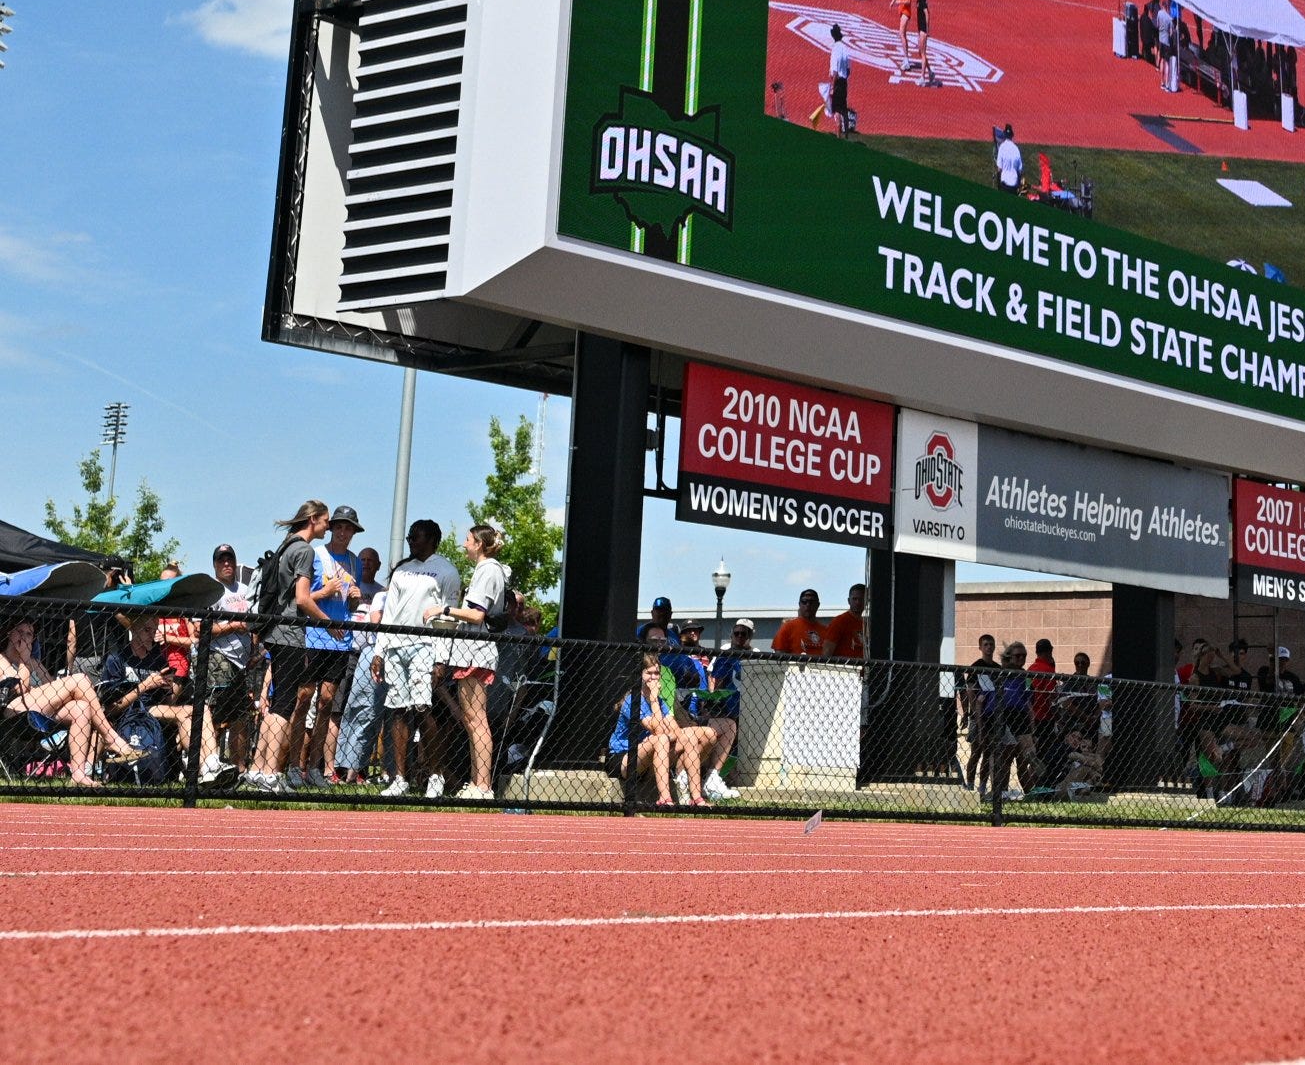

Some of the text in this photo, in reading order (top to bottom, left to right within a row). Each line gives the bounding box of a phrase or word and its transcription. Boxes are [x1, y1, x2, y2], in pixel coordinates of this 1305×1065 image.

[600, 126, 727, 214] OHSAA
[872, 175, 1049, 267] WELCOME
[1053, 232, 1097, 279] TO
[1101, 247, 1160, 300] THE
[1167, 269, 1264, 331] OHSAA
[878, 246, 997, 317] TRACK
[1005, 282, 1028, 324] &
[1037, 290, 1122, 348] FIELD
[1130, 317, 1213, 374] STATE
[722, 386, 862, 445] 2010 NCAA
[698, 423, 881, 486] COLLEGE CUP
[915, 452, 963, 508] OHIO STATE
[689, 482, 884, 539] WOMEN'S SOCCER
[912, 518, 965, 541] VARSITY O
[985, 475, 1067, 519] Athletes
[1073, 490, 1143, 541] Helping
[1148, 505, 1219, 546] Athletes
[1004, 515, 1096, 542] ohiostatebuckeyes.com
[1256, 495, 1293, 527] 2007
[1253, 573, 1296, 601] MEN'S
